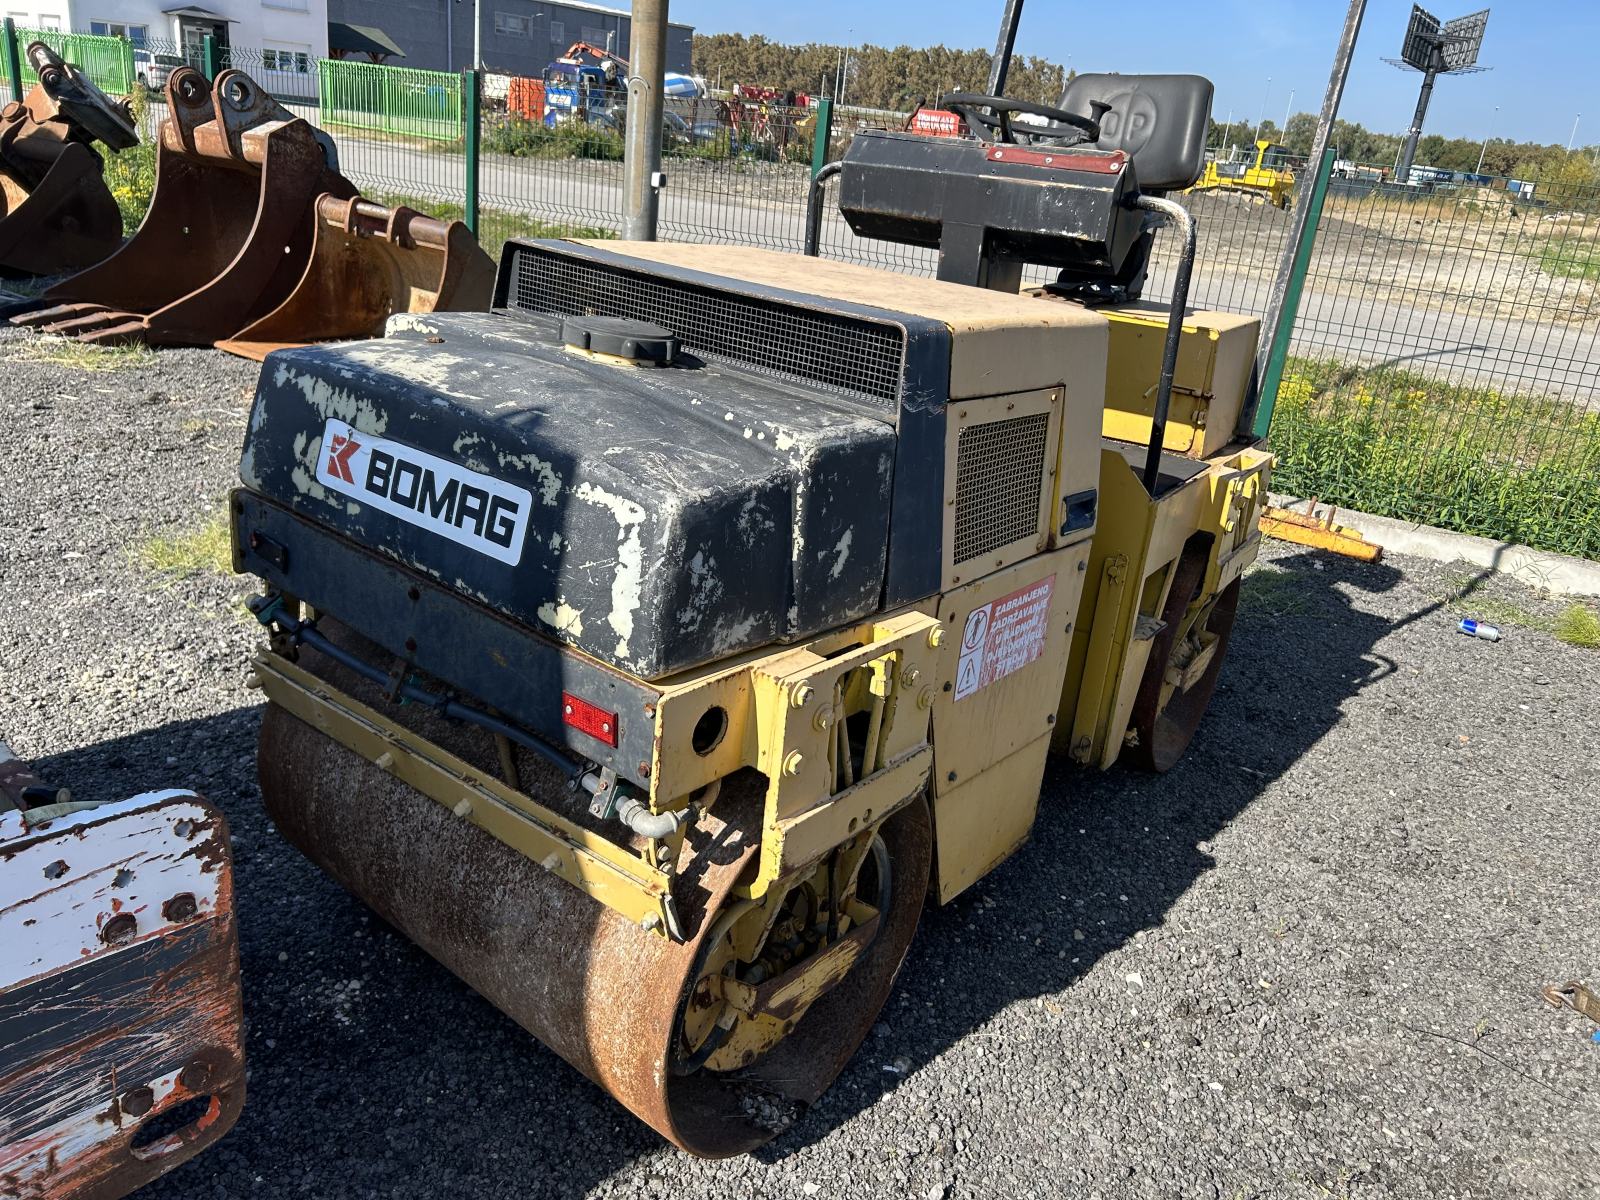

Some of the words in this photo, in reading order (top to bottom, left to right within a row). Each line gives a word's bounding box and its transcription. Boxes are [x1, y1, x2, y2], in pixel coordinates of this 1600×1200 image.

[365, 448, 519, 549] BOMAG
[990, 597, 1048, 632] ZADRŽAVANJE
[994, 584, 1049, 617] ZABRANJENO
